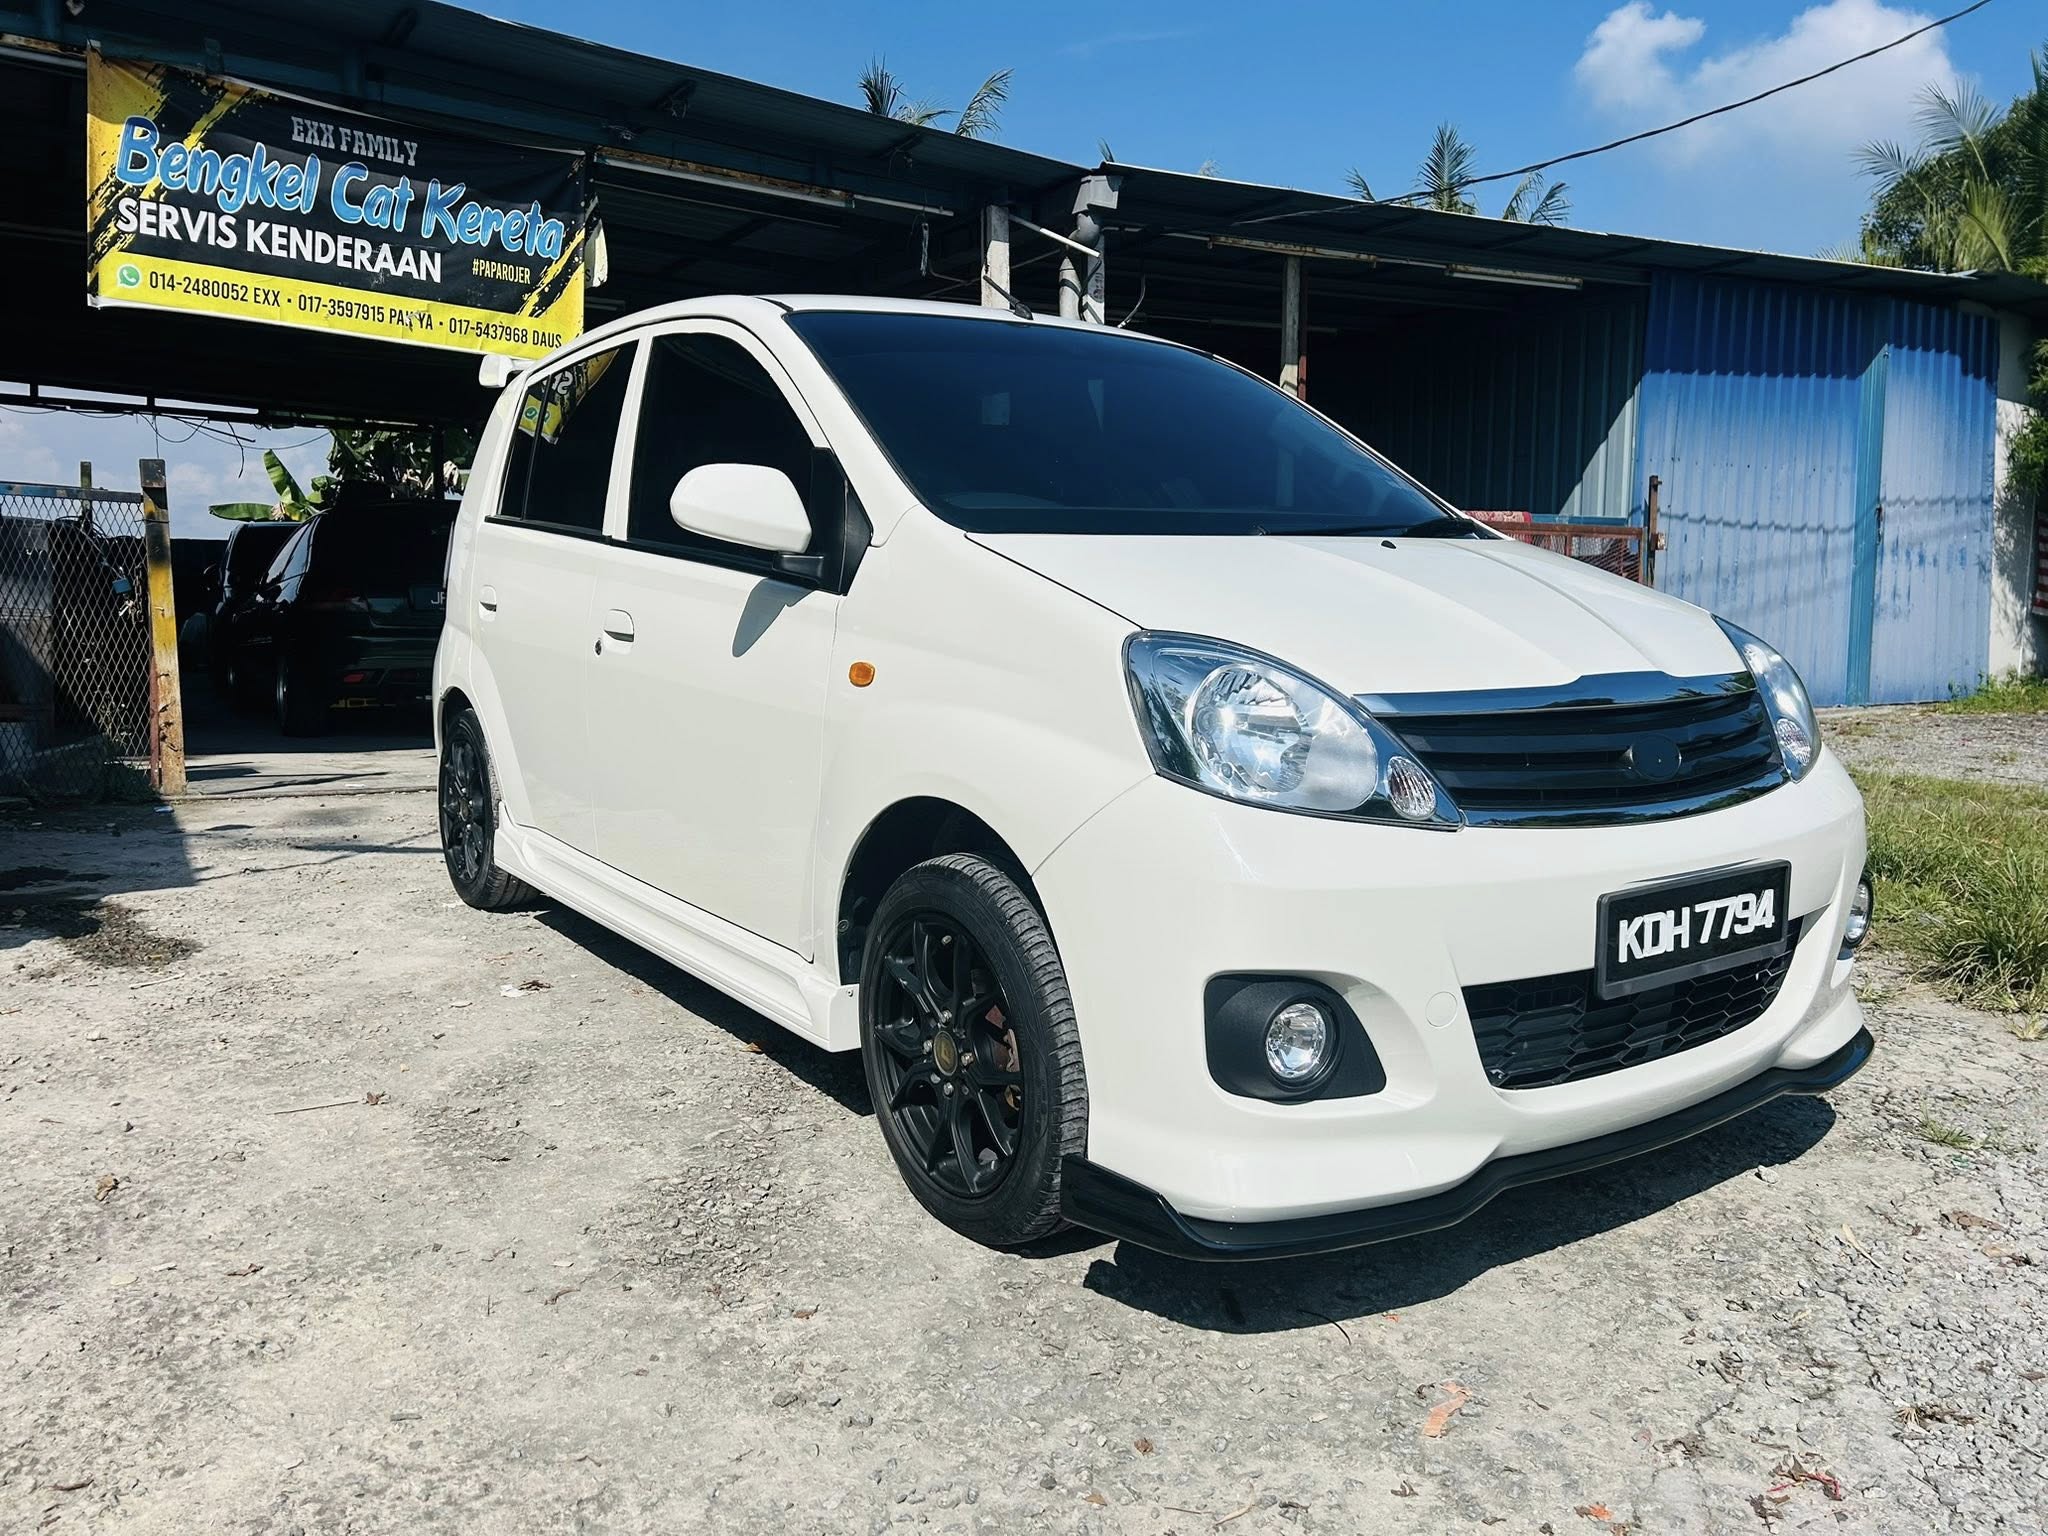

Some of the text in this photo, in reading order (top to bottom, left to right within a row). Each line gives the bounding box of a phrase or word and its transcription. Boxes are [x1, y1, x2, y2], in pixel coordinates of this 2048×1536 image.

[291, 116, 418, 167] EXX FAMILY
[115, 115, 565, 260] Bengkel Cat Kereta
[116, 197, 441, 283] SERVIS KENDERAAN
[472, 258, 531, 285] #PAPAROJER
[149, 271, 249, 301] 014-2480052
[253, 289, 281, 307] EXX
[298, 294, 385, 323] 017-3597915
[418, 312, 433, 330] YA
[449, 317, 528, 344] 017-5437968
[532, 330, 562, 348] DAUS
[1618, 888, 1776, 963] KDH 7794
